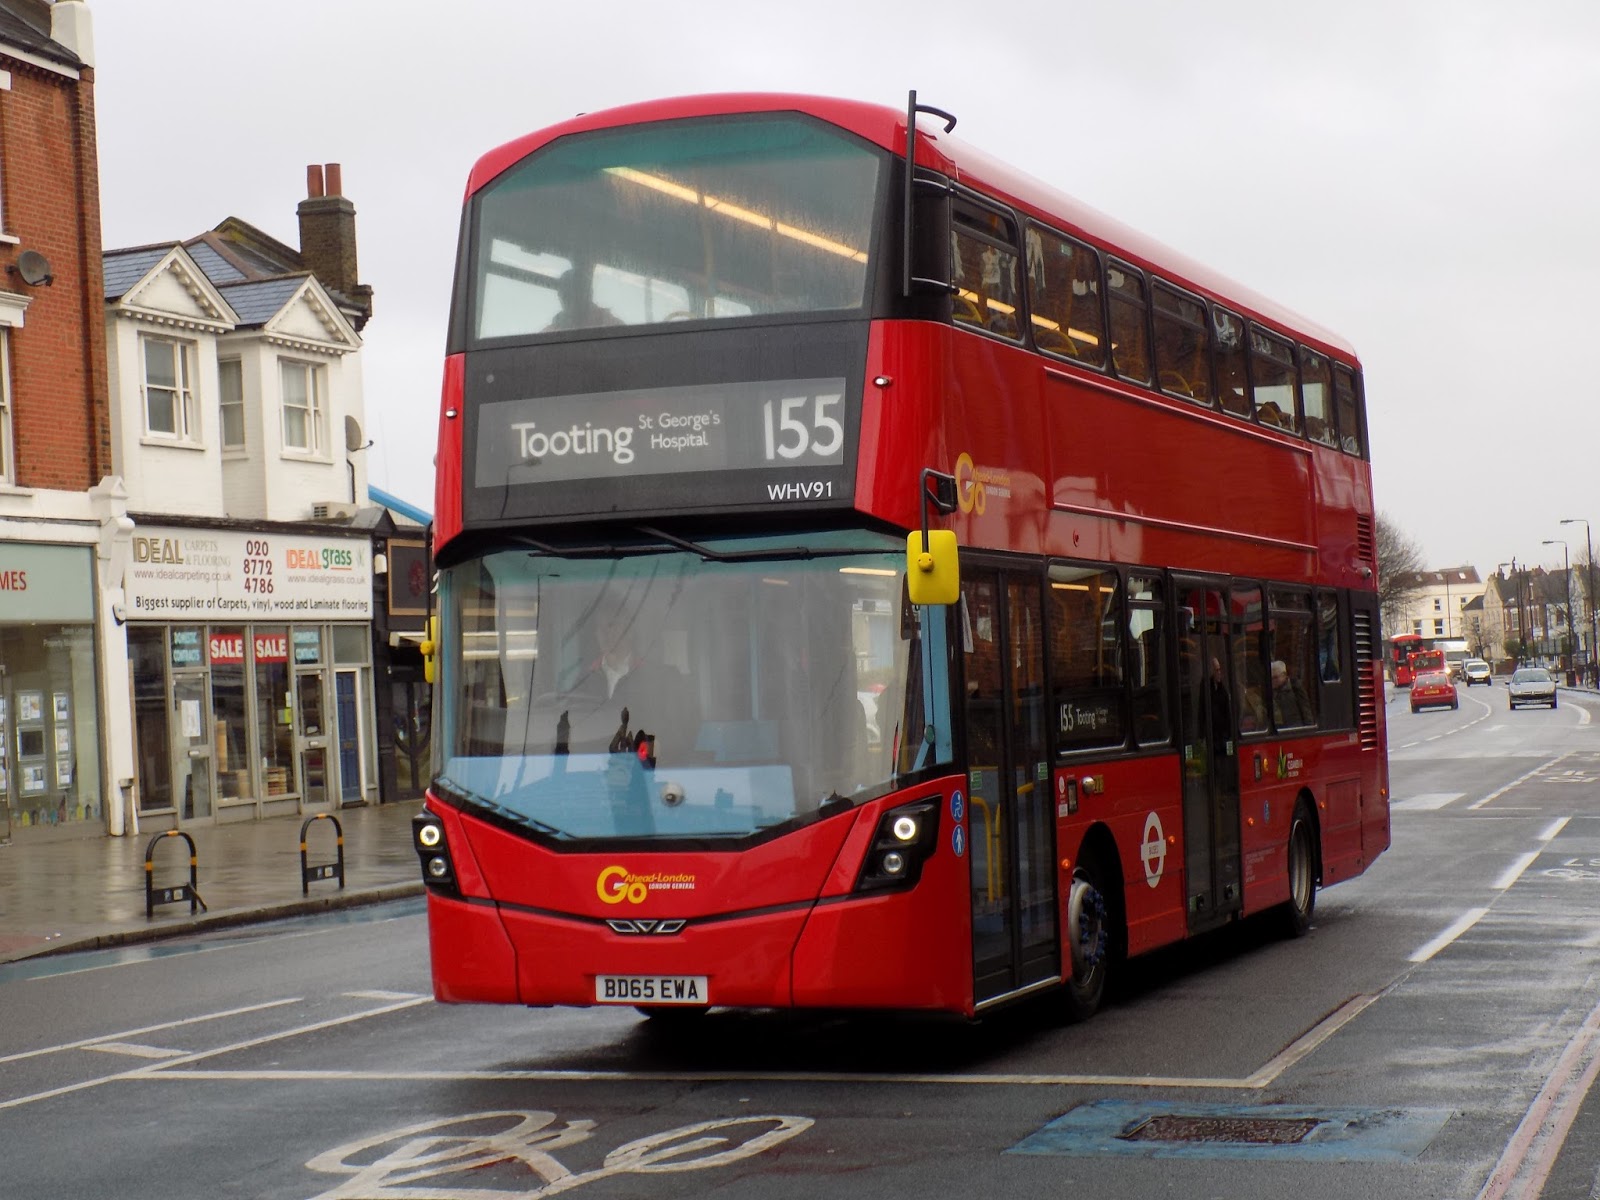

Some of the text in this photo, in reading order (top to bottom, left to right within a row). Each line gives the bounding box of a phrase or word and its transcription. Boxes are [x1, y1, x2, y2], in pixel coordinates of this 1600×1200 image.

[638, 410, 720, 431] St George's
[763, 393, 844, 460] 155
[511, 422, 634, 465] Tooting
[651, 432, 708, 452] Hospital
[767, 481, 833, 501] WHV91
[132, 537, 184, 564] IDEAL
[184, 540, 218, 552] CARPETS
[246, 540, 269, 556] 020
[193, 554, 231, 567] FLOORING
[243, 559, 272, 575] 8772
[244, 578, 274, 594] 4786
[136, 596, 368, 613] Biggest supplier of Carpets, vinyl, wood and Laminate flooring
[211, 639, 243, 658] SALE
[256, 639, 286, 658] SALE
[1060, 703, 1096, 732] 155 Tooting
[596, 866, 647, 904] Go
[625, 873, 695, 882] Ahead-London
[604, 979, 698, 999] BD65 EWA
